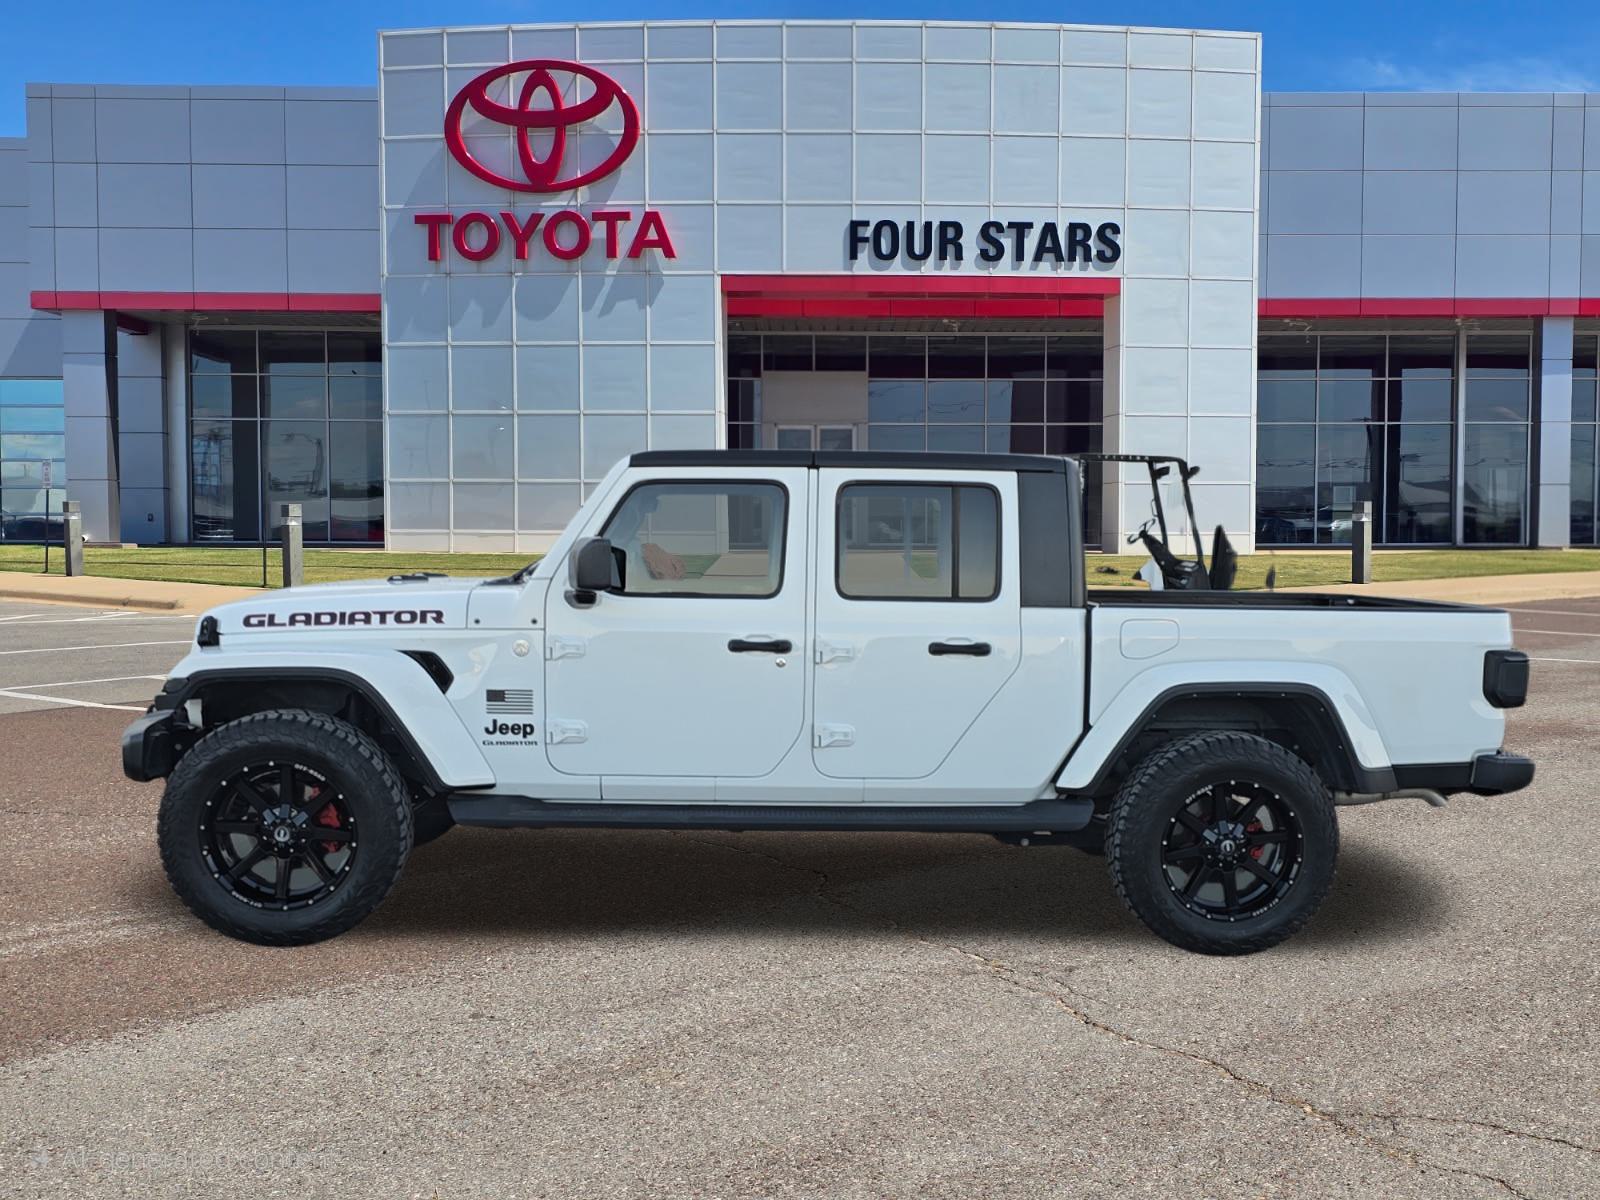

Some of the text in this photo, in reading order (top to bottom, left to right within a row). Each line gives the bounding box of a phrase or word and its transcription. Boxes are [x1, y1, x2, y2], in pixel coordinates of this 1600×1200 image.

[414, 210, 677, 262] TOYOTA
[849, 219, 1122, 263] FOUR STARS
[242, 609, 446, 628] GLADIATOR
[484, 718, 535, 739] Jeep
